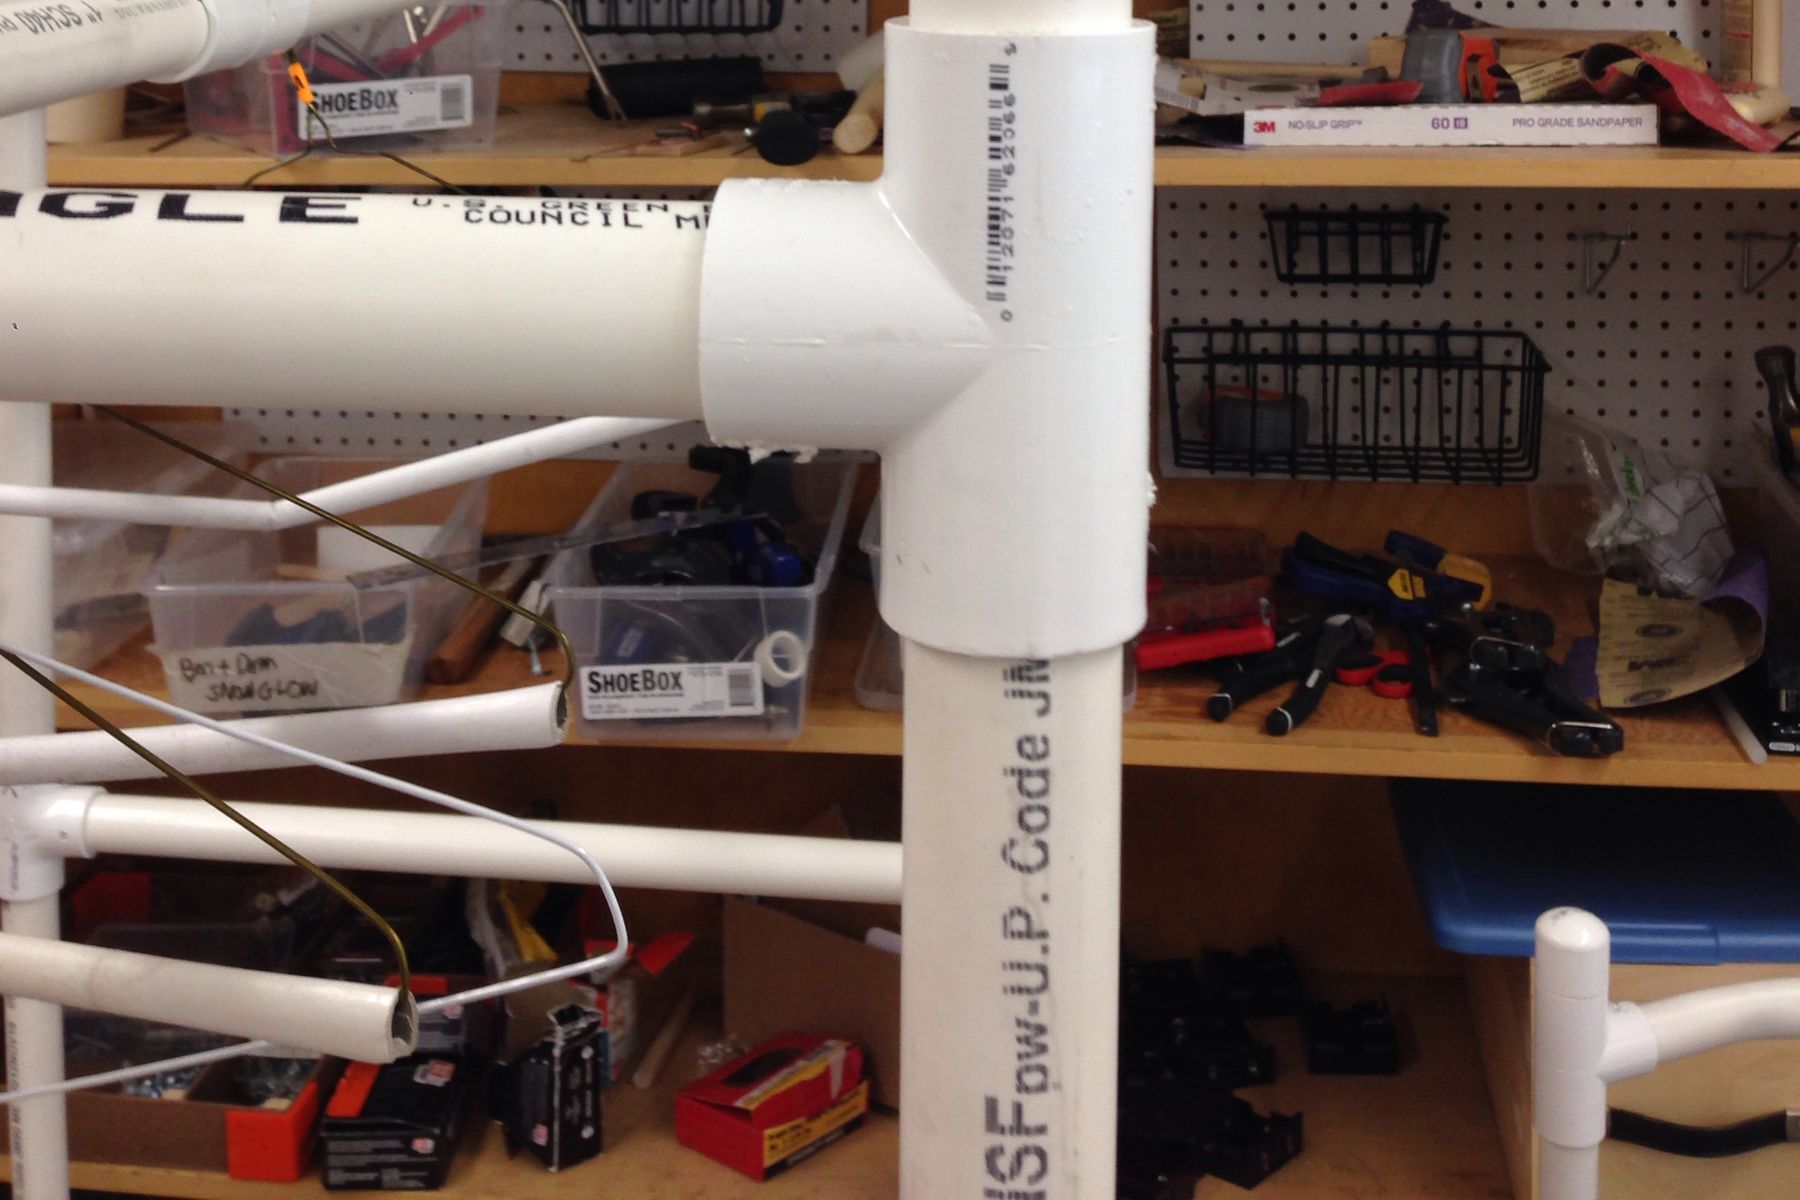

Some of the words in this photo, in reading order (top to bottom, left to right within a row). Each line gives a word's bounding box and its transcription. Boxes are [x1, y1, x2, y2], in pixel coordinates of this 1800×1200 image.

[1253, 121, 1276, 133] 3M
[1288, 120, 1328, 129] NO-SLIP
[1431, 117, 1450, 130] 60
[1512, 118, 1535, 128] PRO
[1537, 117, 1574, 128] GRADE
[1577, 117, 1643, 128] SANDPAPER
[0, 191, 362, 224] GLE
[541, 200, 669, 213] GREEN
[464, 209, 643, 229] COUNCIL
[676, 214, 710, 230] M
[1002, 735, 1051, 875] Code
